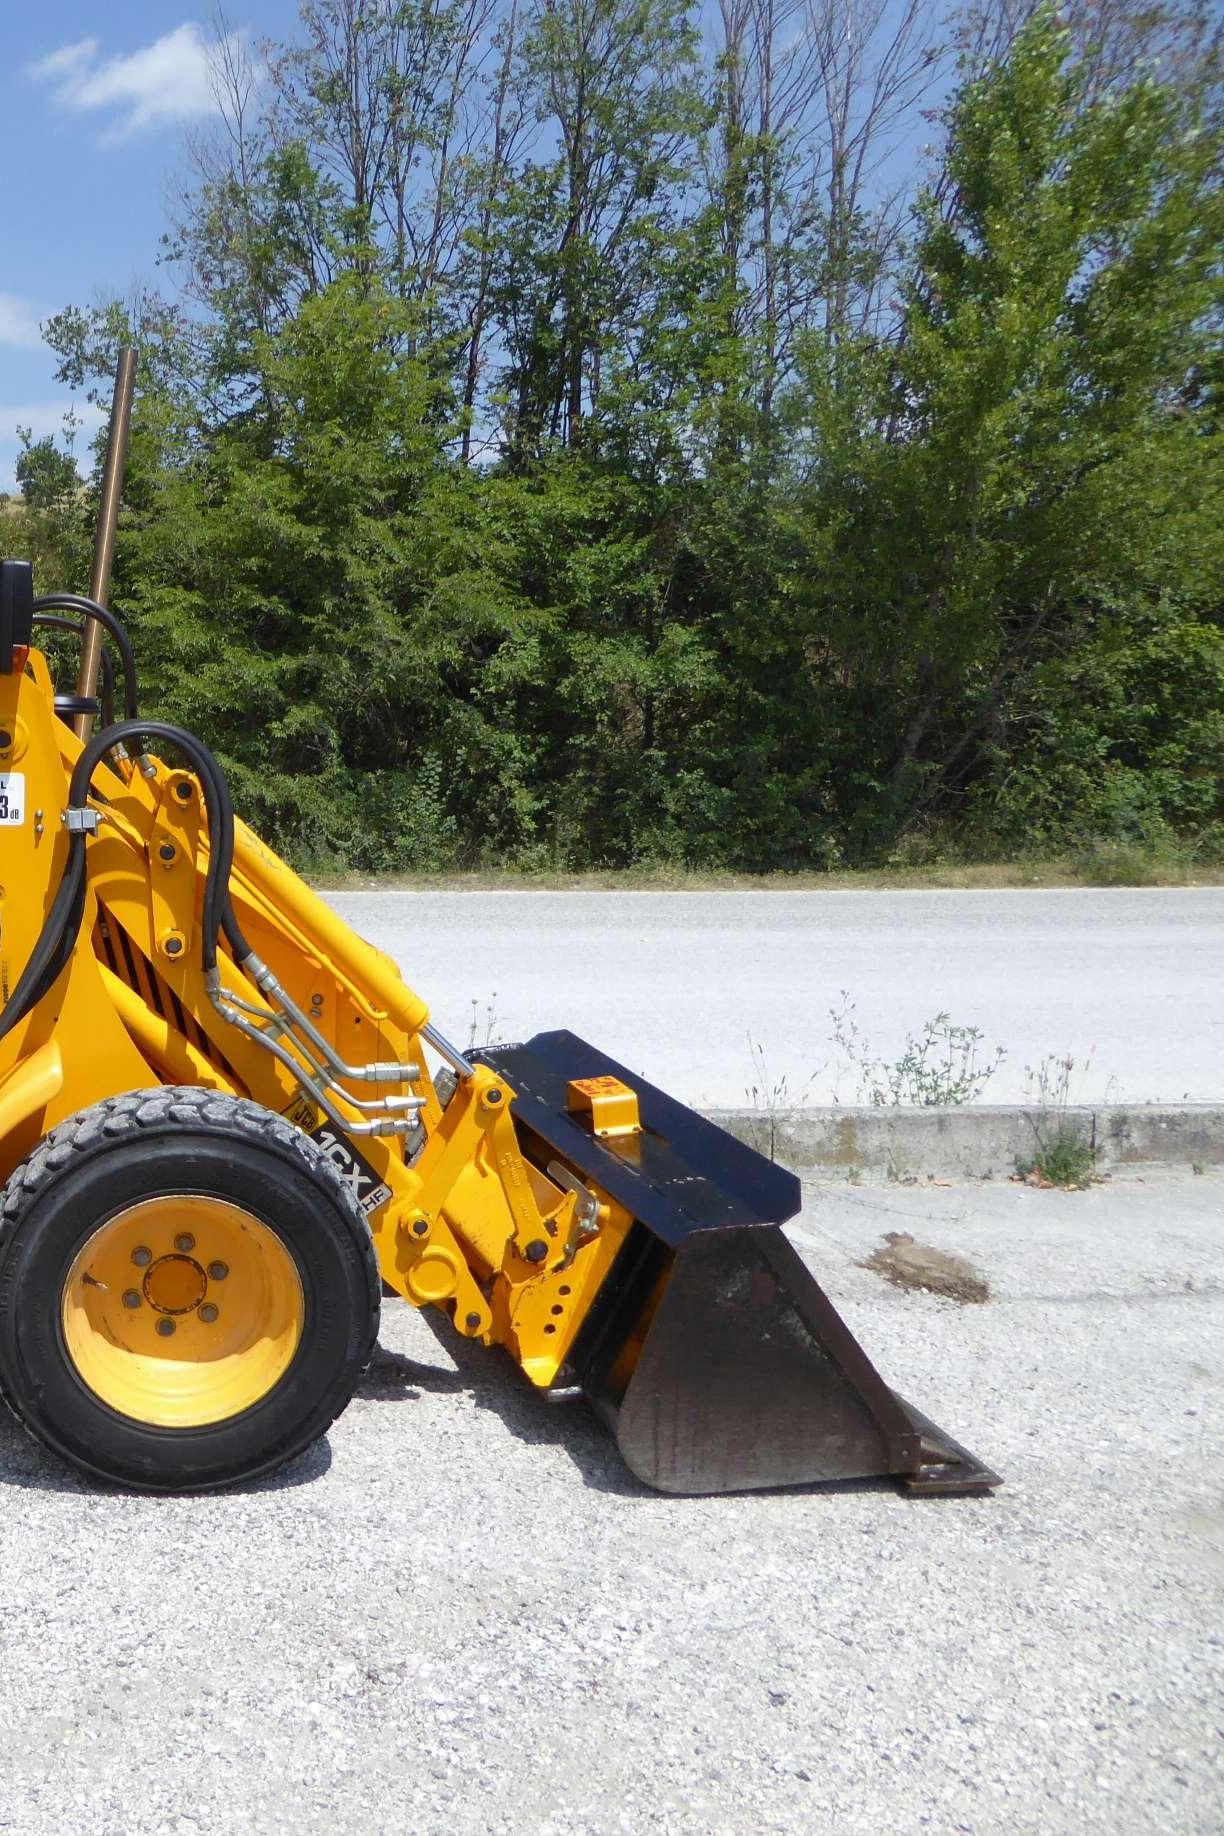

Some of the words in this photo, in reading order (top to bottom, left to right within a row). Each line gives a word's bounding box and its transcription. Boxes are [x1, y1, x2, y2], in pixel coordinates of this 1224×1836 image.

[10, 809, 20, 820] dB
[293, 1105, 316, 1130] JCB
[317, 1131, 373, 1198] 1CX
[362, 1188, 385, 1212] HF
